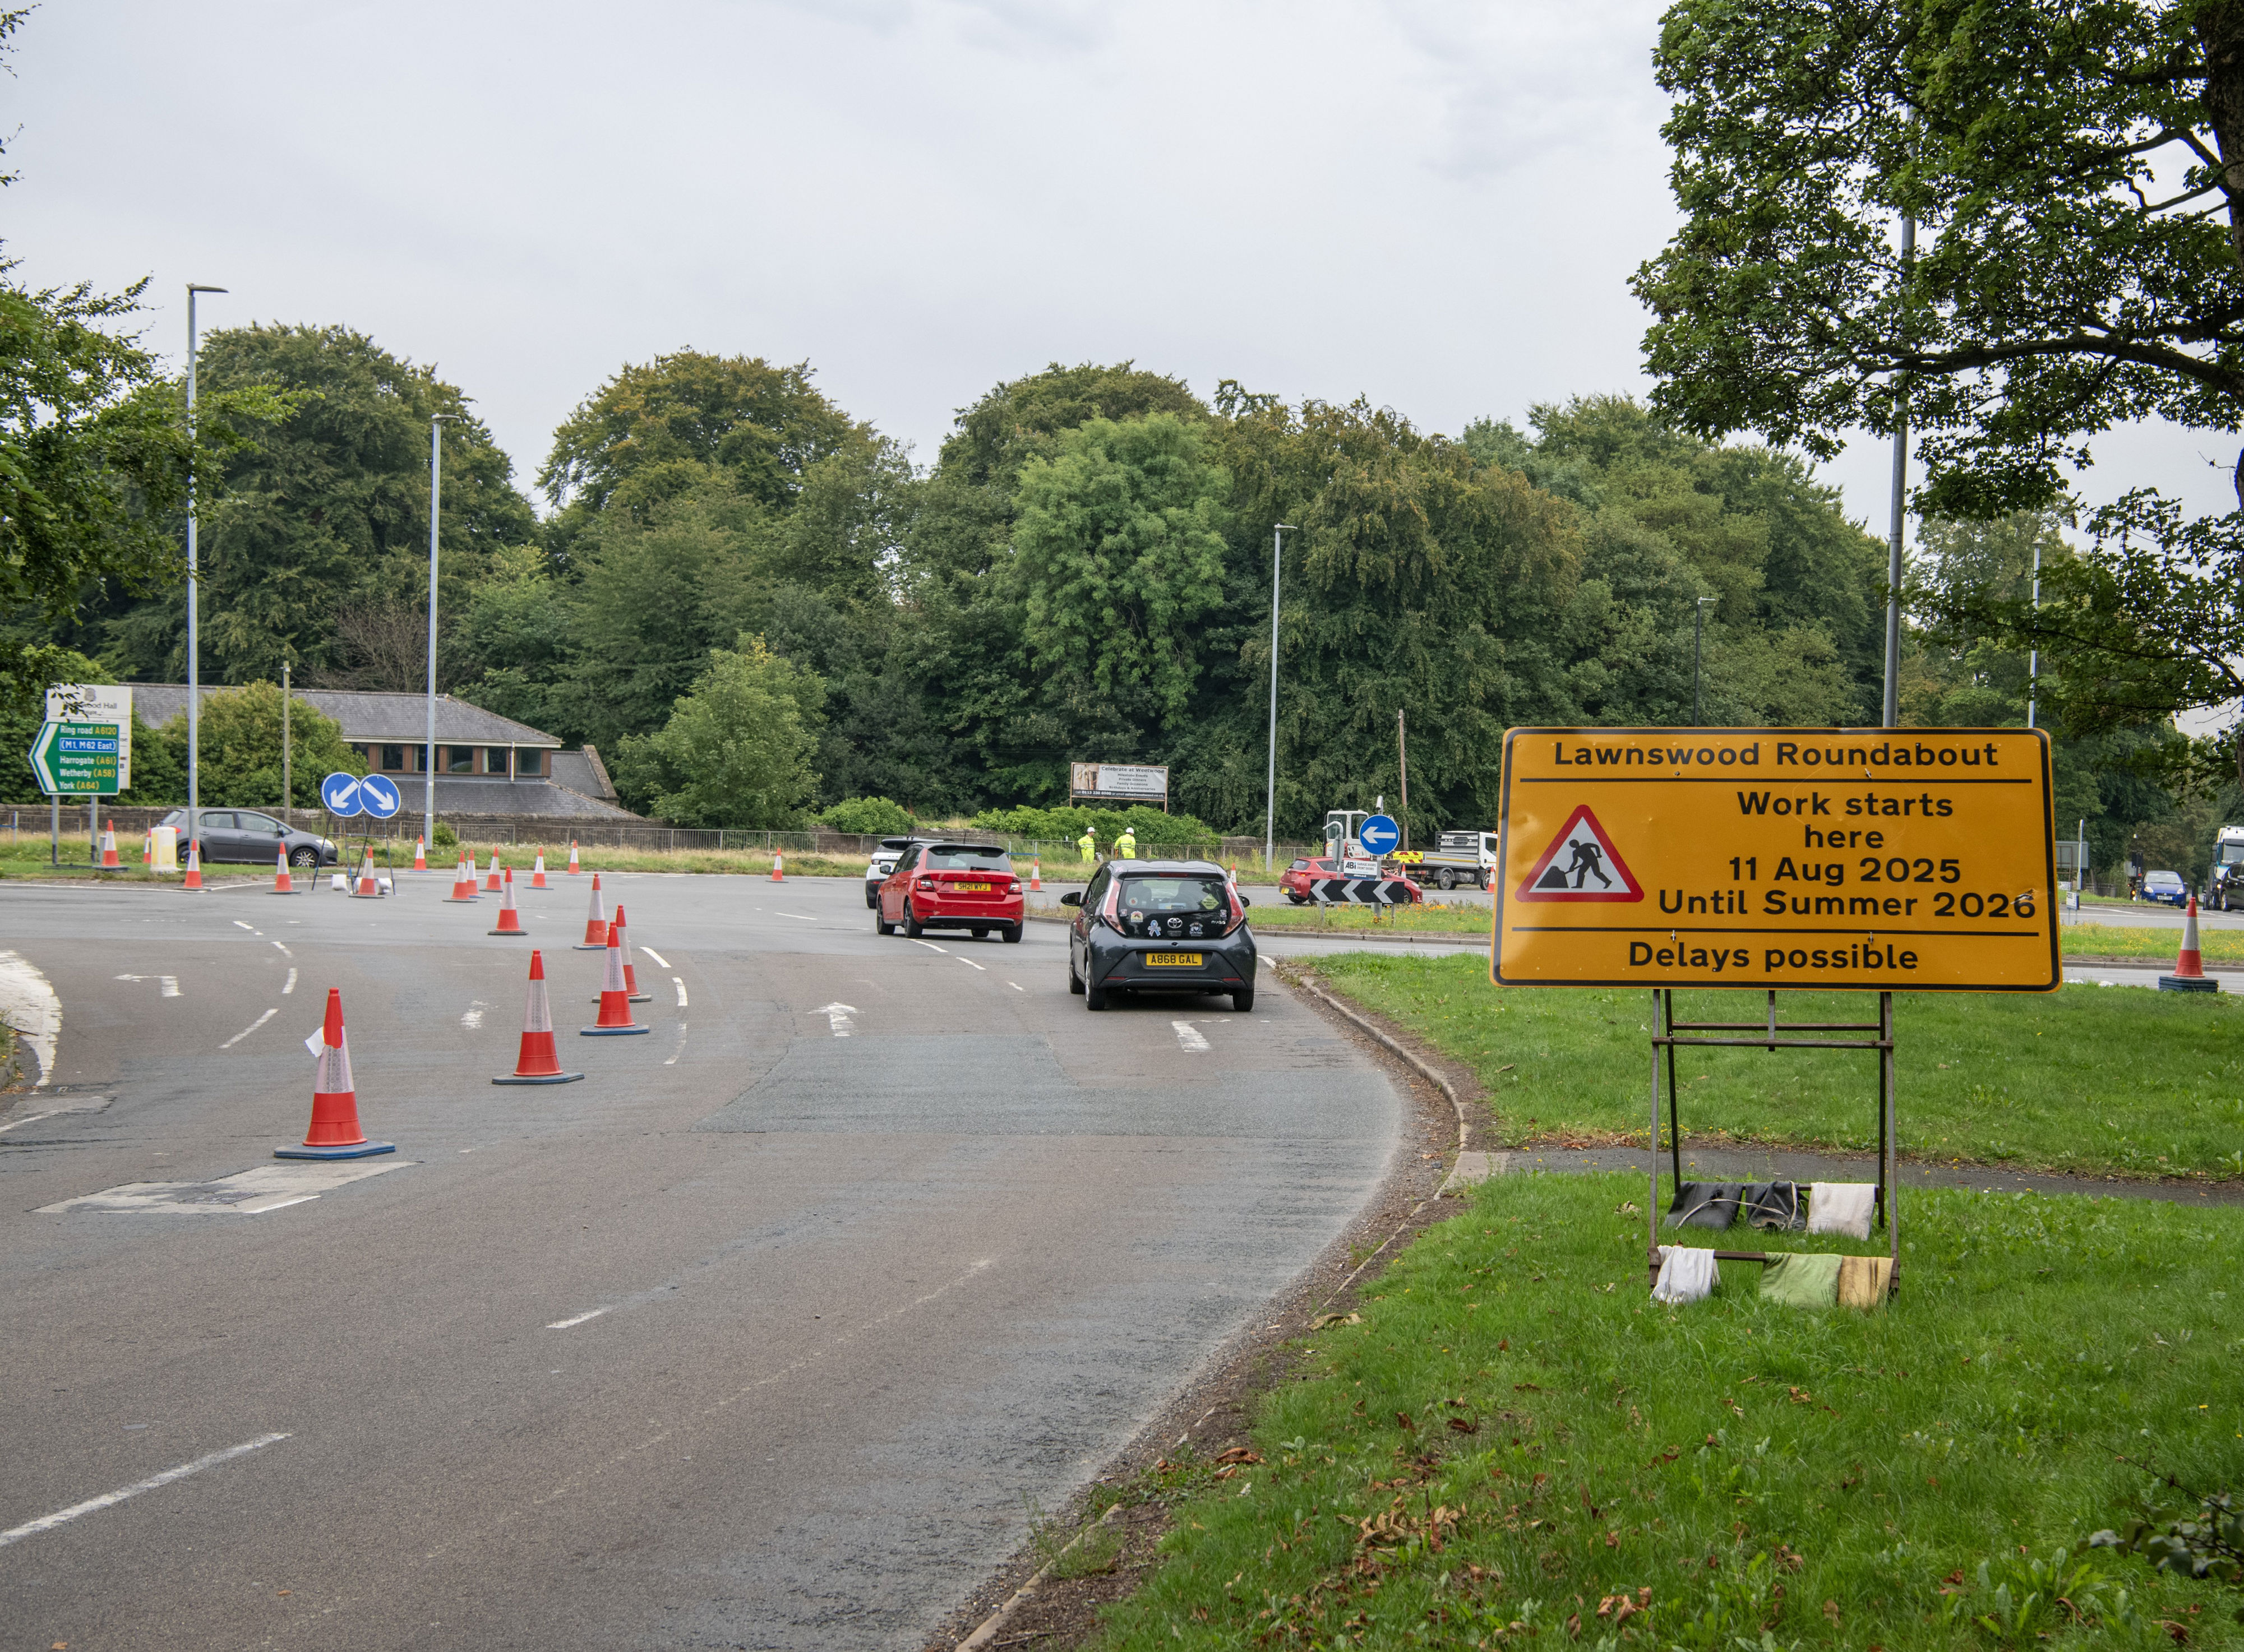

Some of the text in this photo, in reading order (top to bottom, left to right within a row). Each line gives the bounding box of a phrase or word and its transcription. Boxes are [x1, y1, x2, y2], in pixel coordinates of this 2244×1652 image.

[60, 725, 76, 735] Ring
[95, 726, 117, 735] A6120
[79, 741, 96, 749] M62
[98, 741, 116, 751] East)
[1555, 742, 1998, 766] Lawnswood Roundabout
[60, 756, 117, 766] Harrogate (A61)
[59, 768, 116, 779] Wetherby (A58)
[59, 780, 99, 790] York (A64)
[1737, 792, 1954, 817] Work starts
[1805, 824, 1885, 849] here
[1730, 857, 1961, 887] 11 Aug 2025
[1659, 889, 2036, 918] Until Summer 2026
[1151, 955, 1198, 964] A868 GAL
[1629, 941, 1919, 973] Delays possible
